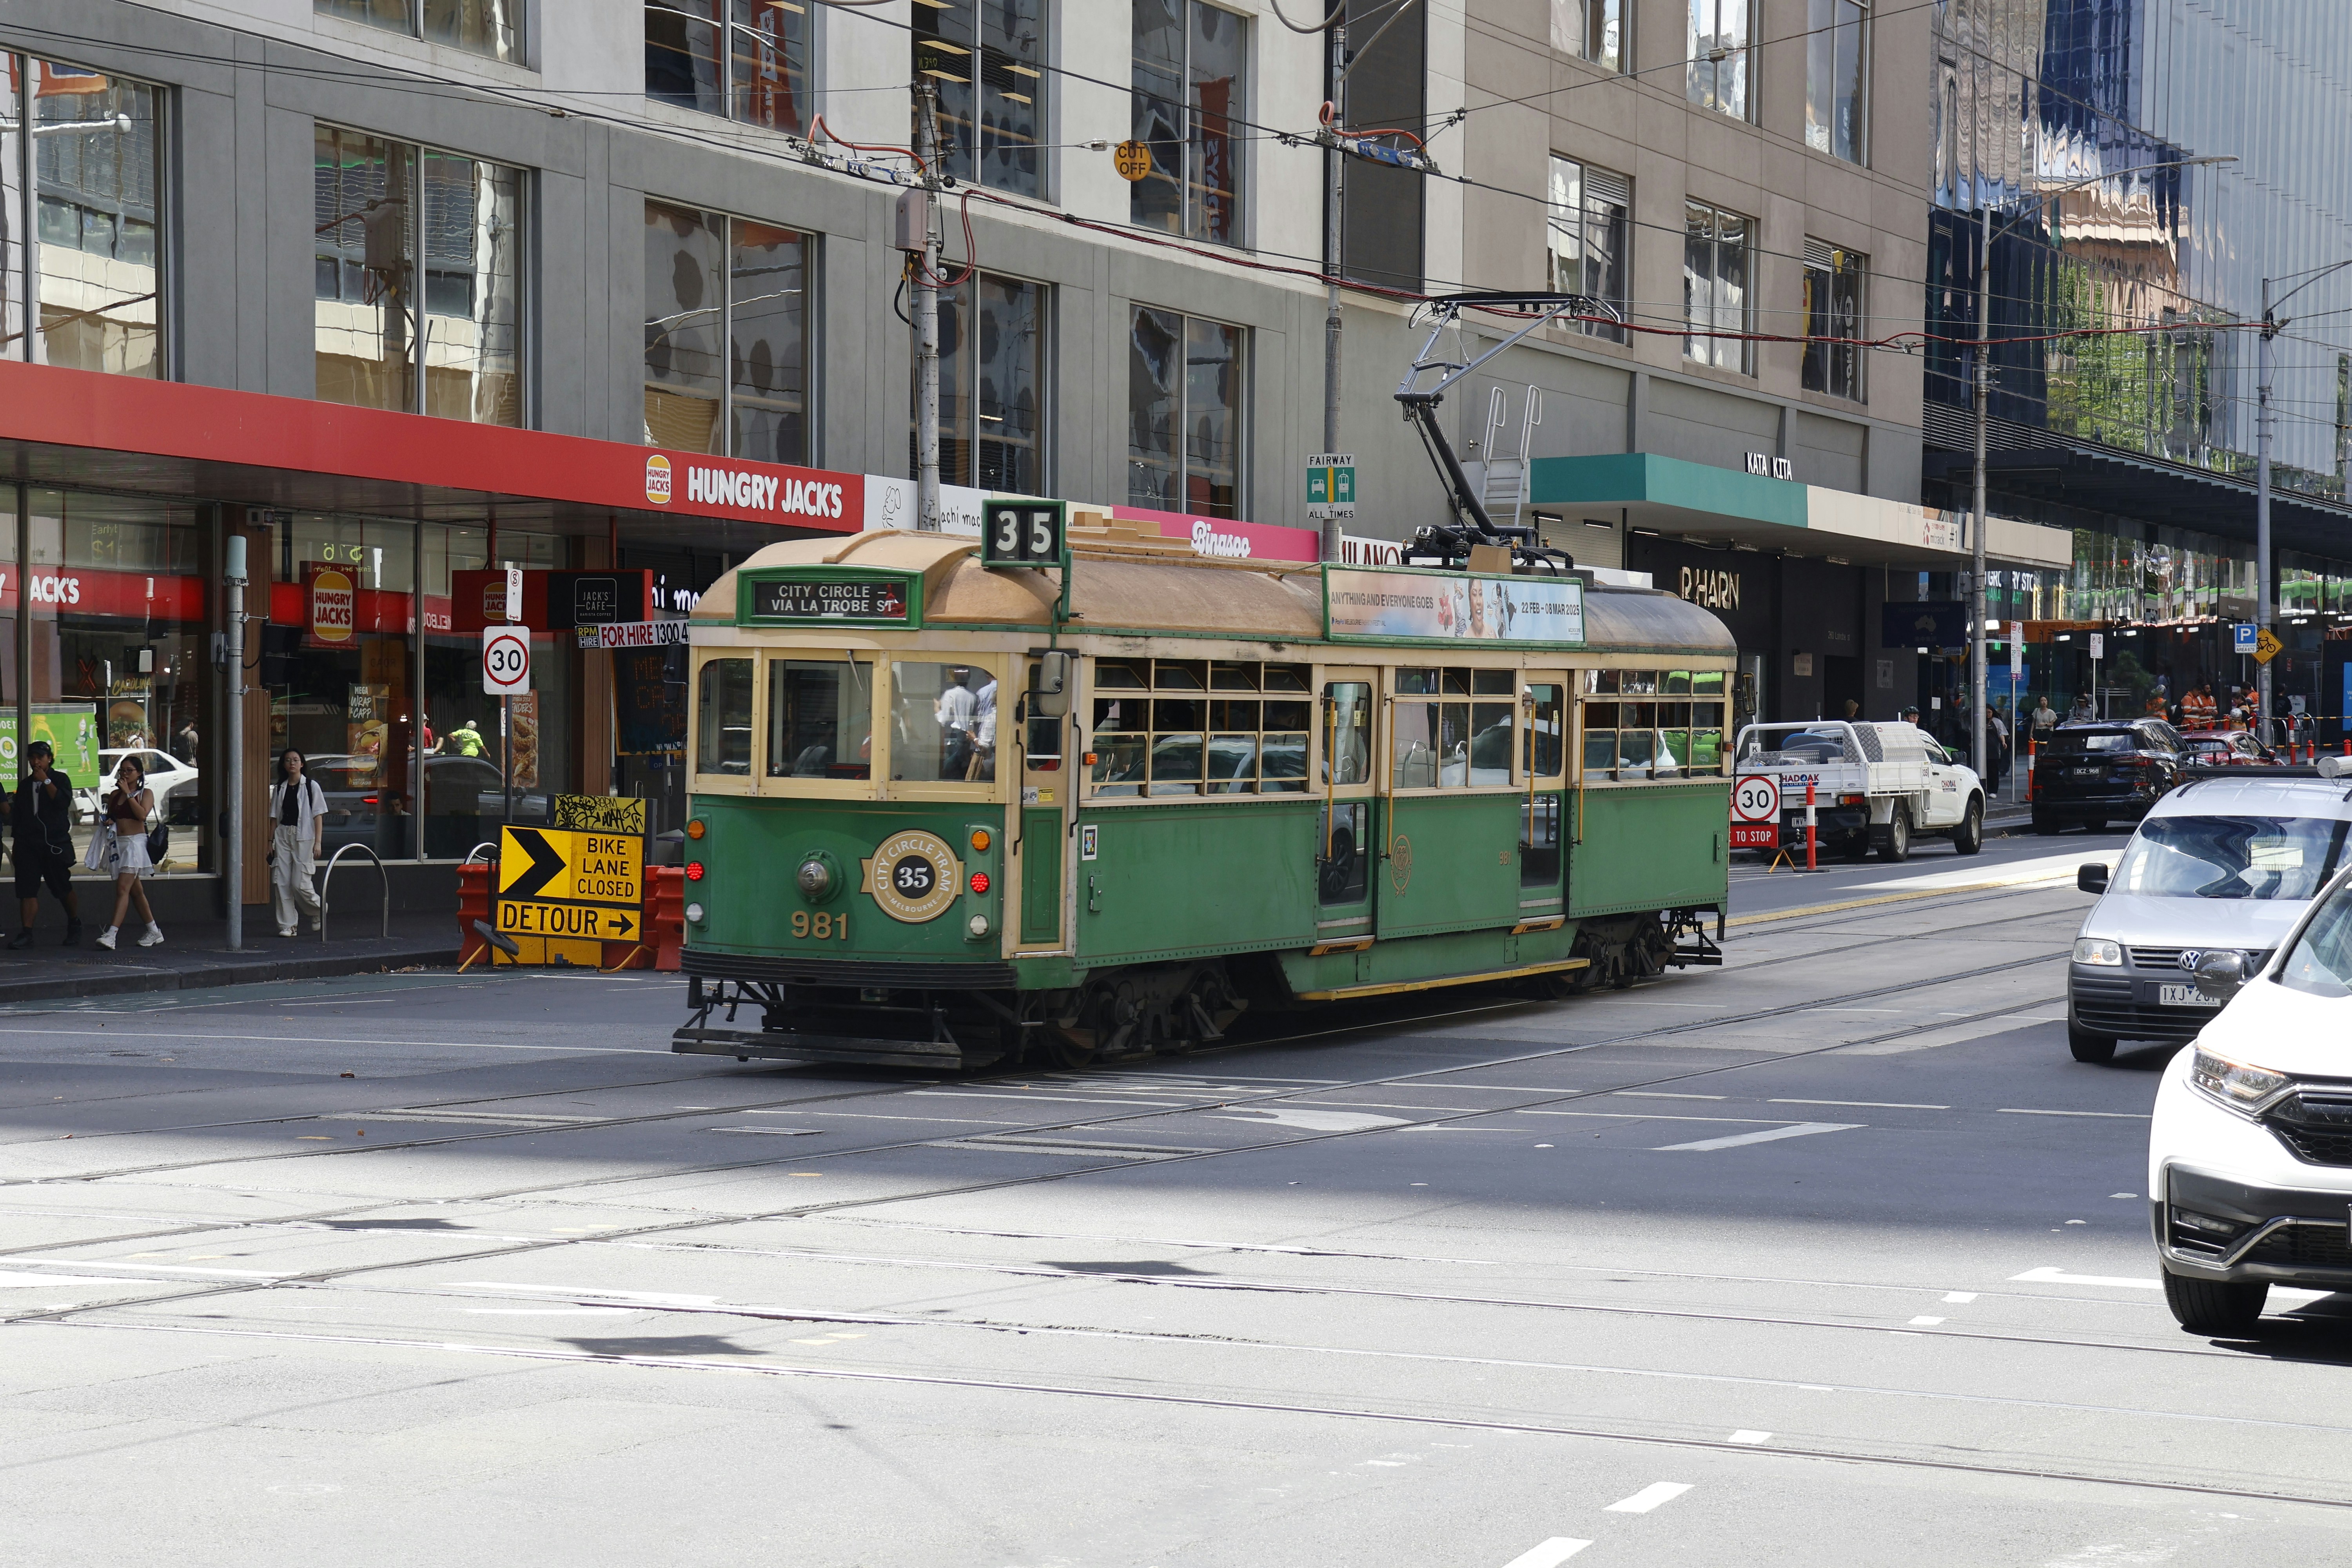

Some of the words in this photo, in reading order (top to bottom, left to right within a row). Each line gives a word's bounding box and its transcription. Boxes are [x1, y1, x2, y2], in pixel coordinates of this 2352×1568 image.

[1118, 146, 1145, 158] CUT
[1120, 162, 1146, 175] OFF
[1310, 456, 1351, 465] FAIRWAY
[1745, 452, 1767, 476] KATA
[1771, 457, 1793, 481] KITA
[648, 469, 670, 479] HUNGRY
[648, 480, 670, 493] JACK'S
[688, 466, 779, 511] HUNGRY
[781, 477, 843, 519] JACK'S
[940, 506, 959, 524] achi
[996, 511, 1051, 554] 35
[1930, 534, 1944, 545] mtrack
[1949, 527, 1958, 548] #1
[30, 575, 80, 604] ACK'S
[583, 592, 608, 601] JACK'S
[779, 585, 811, 597] CITY
[818, 586, 870, 598] CIRCLE
[1986, 587, 2001, 602] HANA
[2012, 591, 2023, 605] ART
[315, 592, 351, 606] HUNGRY
[485, 601, 506, 611] JAC
[586, 602, 606, 610] CAFE
[771, 599, 794, 611] VIA
[801, 600, 818, 612] LA
[822, 600, 869, 612] TROBE
[877, 601, 894, 612] ST
[1331, 592, 1365, 606] ANYTHING
[1367, 593, 1380, 606] AND
[1381, 594, 1415, 608] EVERYONE
[1416, 597, 1434, 609] GOES
[315, 606, 351, 625] JACK'S
[1521, 602, 1529, 613] 22
[1530, 602, 1540, 614] FEB
[1545, 603, 1552, 614] 08
[1553, 603, 1565, 615] MAR
[1566, 604, 1580, 616] 2025
[578, 626, 598, 637] RPM
[601, 626, 626, 647] FOR
[628, 624, 654, 646] HIRE
[655, 622, 680, 644] 1300
[2240, 628, 2251, 641] P
[579, 638, 598, 647] HIRE
[491, 650, 521, 671] 30
[354, 686, 368, 695] MEGA
[350, 695, 372, 707] WRAP
[512, 703, 534, 713] ENDERS
[353, 707, 372, 719] CAPP
[1742, 790, 1769, 808] 30
[1736, 831, 1746, 842] TO
[1750, 831, 1771, 842] STOP
[587, 837, 626, 855] BIKE
[877, 858, 890, 890] CITY
[888, 839, 935, 858] CIRCLE
[934, 850, 952, 892] TRAM
[1499, 851, 1512, 866] 981
[583, 857, 630, 877] LANE
[897, 866, 929, 888] 35
[577, 878, 634, 897] CLOSED
[890, 897, 938, 912] MELBOURNE
[503, 903, 599, 935] DETOUR
[791, 911, 847, 940] 981
[2163, 987, 2185, 1001] 1XJ
